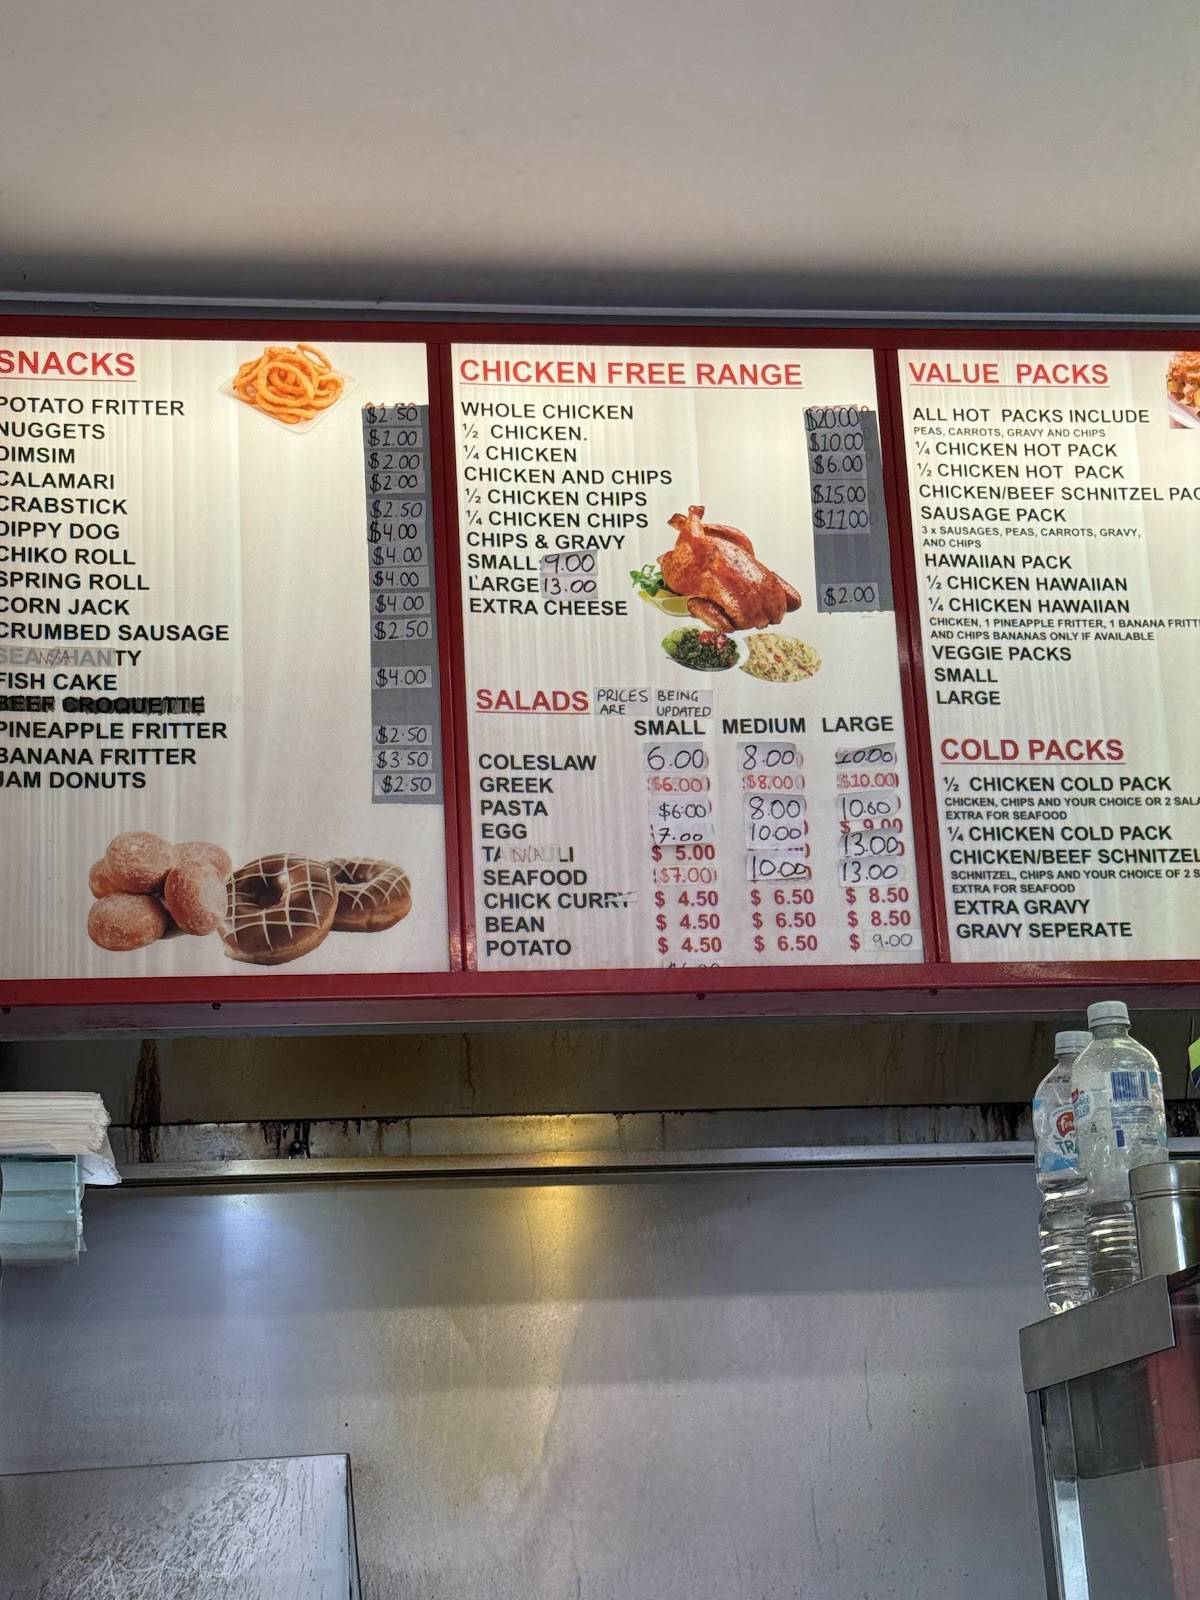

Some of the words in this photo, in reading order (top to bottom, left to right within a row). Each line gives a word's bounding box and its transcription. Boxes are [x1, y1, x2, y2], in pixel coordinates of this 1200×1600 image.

[0, 350, 135, 376] SNACKS
[460, 359, 596, 384] CHICKEN
[607, 362, 686, 385] FREE
[696, 363, 802, 386] RANGE
[909, 363, 999, 383] VALUE
[1016, 364, 1109, 385] PACKS
[92, 399, 185, 416] FRITTER
[366, 406, 418, 424] $2.50
[461, 401, 536, 419] WHOLE
[543, 404, 633, 420] CHICKEN
[913, 408, 948, 422] ALL
[953, 409, 990, 422] HOT
[1002, 410, 1063, 423] PACKS
[1069, 410, 1150, 423] INCLUDE
[0, 421, 105, 439] NUGGETS
[367, 428, 417, 447] $1.00
[490, 424, 588, 441] CHICKEN.
[914, 426, 945, 437] PEAS,
[948, 427, 1004, 438] CARROTS,
[1007, 428, 1043, 438] GRAVY
[1047, 428, 1070, 438] AND
[1073, 429, 1106, 438] CHIPS
[810, 432, 863, 452] $10.00
[936, 442, 1017, 456] CHICKEN
[1024, 443, 1061, 457] HOT
[1068, 444, 1119, 457] PACK
[368, 452, 420, 470] $2.00
[486, 446, 577, 462] CHICKEN
[813, 455, 863, 475] $6.00
[937, 463, 1019, 478] CHICKEN
[1026, 465, 1063, 478] HOT
[1075, 465, 1125, 479] PACK
[0, 470, 114, 489] CALAMARI
[369, 473, 418, 494] $2.00
[464, 466, 555, 484] CHICKEN
[561, 470, 604, 485] AND
[611, 470, 673, 485] CHIPS
[487, 489, 579, 506] CHICKEN
[586, 491, 647, 507] CHIPS
[919, 484, 1055, 500] CHICKEN/BEEF
[1061, 486, 1163, 501] SCHNITZEL
[0, 495, 128, 515] CRABSTICK
[370, 500, 423, 519] $2.50
[488, 511, 580, 528] CHICKEN
[587, 513, 648, 529] CHIPS
[921, 506, 1010, 522] SAUSAGE
[1016, 508, 1067, 522] PACK
[70, 523, 120, 540] DOG
[368, 520, 418, 544] $4.00
[939, 526, 1003, 537] SAUSAGES,
[1005, 527, 1038, 537] PEAS,
[1040, 528, 1097, 538] CARROTS,
[1099, 528, 1141, 539] GRAVY,
[467, 532, 528, 549] CHIPS
[535, 535, 549, 550] &
[555, 535, 626, 550] GRAVY
[923, 539, 946, 548] AND
[949, 539, 982, 548] CHIPS
[75, 548, 136, 565] ROLL
[372, 546, 422, 566] $4.00
[468, 553, 538, 571] SMALL
[544, 553, 595, 574] 9.00
[925, 554, 1015, 569] HAWAIIAN
[1022, 555, 1073, 570] PACK
[89, 574, 150, 590] ROLL
[373, 571, 419, 587] $4.00
[469, 576, 539, 593] LARGE
[544, 578, 597, 595] 13.00
[947, 576, 1030, 591] CHICKEN
[1036, 577, 1128, 592] HAWAIIAN
[375, 595, 424, 614] $4.00
[824, 587, 875, 607] $2.00
[68, 599, 130, 616] JACK
[470, 599, 538, 616] EXTRA
[544, 601, 628, 616] CHEESE
[950, 598, 1032, 613] CHICKEN
[1038, 599, 1130, 614] HAWAIIAN
[374, 620, 429, 640] $2.50
[929, 617, 982, 629] CHICKEN,
[993, 618, 1055, 628] PINEAPPLE
[1118, 619, 1165, 628] BANANA
[119, 624, 230, 641] SAUSAGE
[931, 630, 954, 640] AND
[957, 630, 990, 640] CHIPS
[993, 631, 1047, 641] BANANAS
[1050, 631, 1079, 641] ONLY
[1082, 632, 1091, 641] IF
[1094, 631, 1155, 641] AVAILABLE
[932, 645, 1002, 661] VEGGIE
[1008, 646, 1071, 662] PACKS
[53, 674, 117, 691] CAKE
[375, 669, 427, 688] $4.00
[934, 667, 998, 683] SMALL
[476, 688, 589, 712] SALADS
[597, 689, 649, 703] PRICES
[657, 690, 698, 702] BEING
[936, 690, 1001, 706] LARGE
[600, 704, 626, 715] ARE
[657, 706, 712, 718] UPDATED
[132, 722, 228, 739] FRITTER
[634, 720, 706, 736] SMALL
[722, 717, 806, 734] MEDIUM
[822, 716, 894, 733] LARGE
[101, 748, 197, 765] FRITTER
[940, 738, 1020, 761] COLD
[1028, 739, 1124, 761] PACKS
[478, 753, 597, 771] COLESLAW
[50, 772, 146, 789] DONUTS
[480, 777, 554, 793] GREEK
[969, 776, 1055, 792] CHICKEN
[1060, 776, 1114, 792] COLD
[1120, 776, 1172, 792] PACK
[481, 800, 549, 817] PASTA
[1001, 797, 1035, 808] CHIPS
[1037, 797, 1061, 807] AND
[1064, 797, 1096, 807] YOUR
[1099, 797, 1142, 807] CHOICE
[946, 811, 983, 821] EXTRA
[986, 811, 1010, 821] FOR
[1012, 811, 1068, 821] SEAFOOD
[481, 823, 528, 840] EGG
[969, 826, 1055, 842] CHICKEN
[1060, 826, 1114, 842] COLD
[1120, 826, 1173, 842] PACK
[676, 845, 715, 861] 5.00
[950, 849, 1092, 865] CHICKEN/BEEF
[483, 869, 588, 886] SEAFOOD
[1020, 870, 1054, 880] CHIPS
[1056, 870, 1081, 880] AND
[1083, 870, 1116, 880] YOUR
[1119, 870, 1162, 879] CHOICE
[1165, 870, 1181, 879] OF
[774, 889, 815, 905] 6.50
[869, 887, 909, 903] 8.50
[952, 884, 990, 894] EXTRA
[993, 884, 1017, 894] FOR
[1020, 884, 1076, 894] SEAFOOD
[484, 892, 551, 910] CHICK
[679, 891, 718, 906] 4.50
[954, 900, 1019, 915] EXTRA
[1024, 899, 1090, 914] GRAVY
[486, 916, 545, 933] BEAN
[680, 914, 720, 930] 4.50
[776, 912, 816, 928] 6.50
[871, 910, 911, 927] 8.50
[956, 923, 1023, 939] GRAVY
[1029, 922, 1133, 938] SEPERATE
[487, 939, 572, 957] POTATO
[682, 937, 722, 953] 4.50
[778, 935, 818, 951] 6.50
